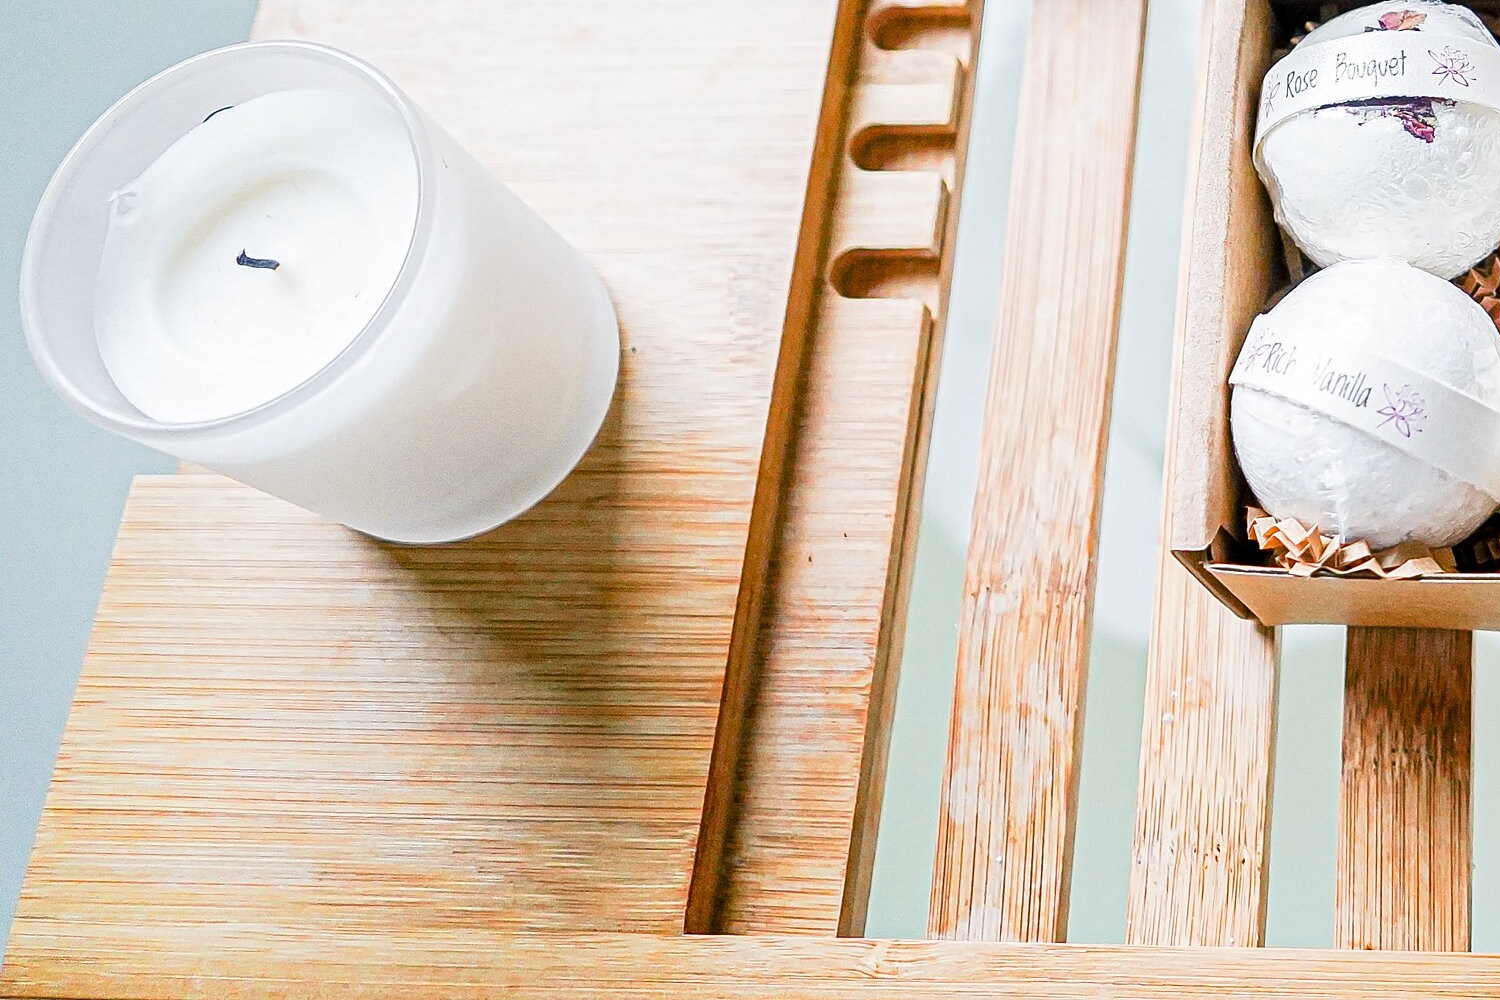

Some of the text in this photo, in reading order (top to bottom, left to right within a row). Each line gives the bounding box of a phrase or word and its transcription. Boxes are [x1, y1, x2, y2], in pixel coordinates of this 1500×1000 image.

[1285, 50, 1408, 99] Rose Bouquet
[1263, 341, 1373, 408] Rich Vanilla
